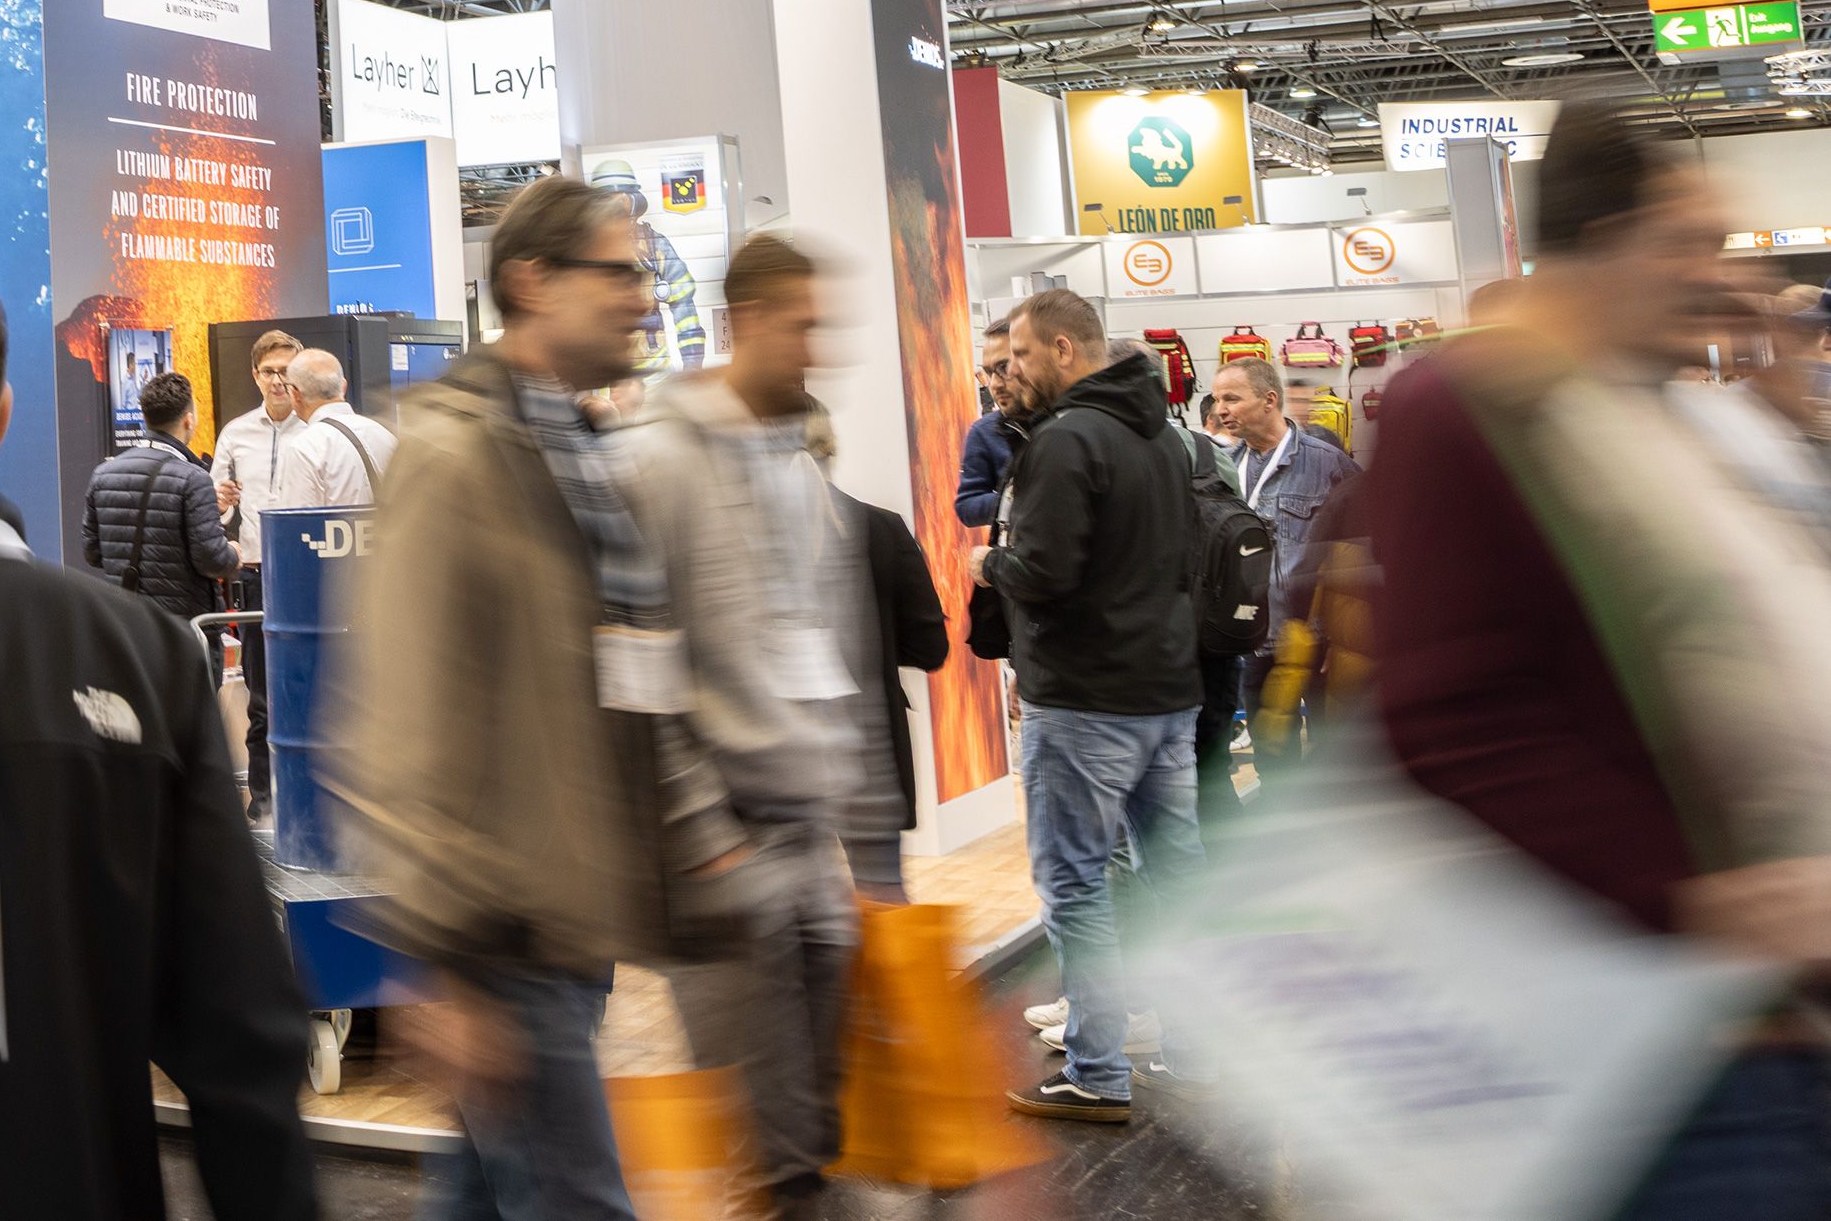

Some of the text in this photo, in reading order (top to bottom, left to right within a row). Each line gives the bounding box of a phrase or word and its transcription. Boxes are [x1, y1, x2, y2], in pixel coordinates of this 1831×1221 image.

[173, 5, 192, 17] WORK
[194, 8, 218, 22] SAFETY
[352, 43, 414, 91] Layher
[126, 72, 258, 121] FIRE PROTECTION
[1401, 117, 1518, 134] INDUSTRIAL
[116, 149, 272, 192] LITHIUM BATTERY SAFETY
[111, 190, 280, 230] AND CERTIFIED STORAGE OF
[1118, 204, 1157, 234] LEÓN
[1160, 208, 1180, 232] DE
[121, 232, 276, 268] FLAMMABLE SUBSTANCES
